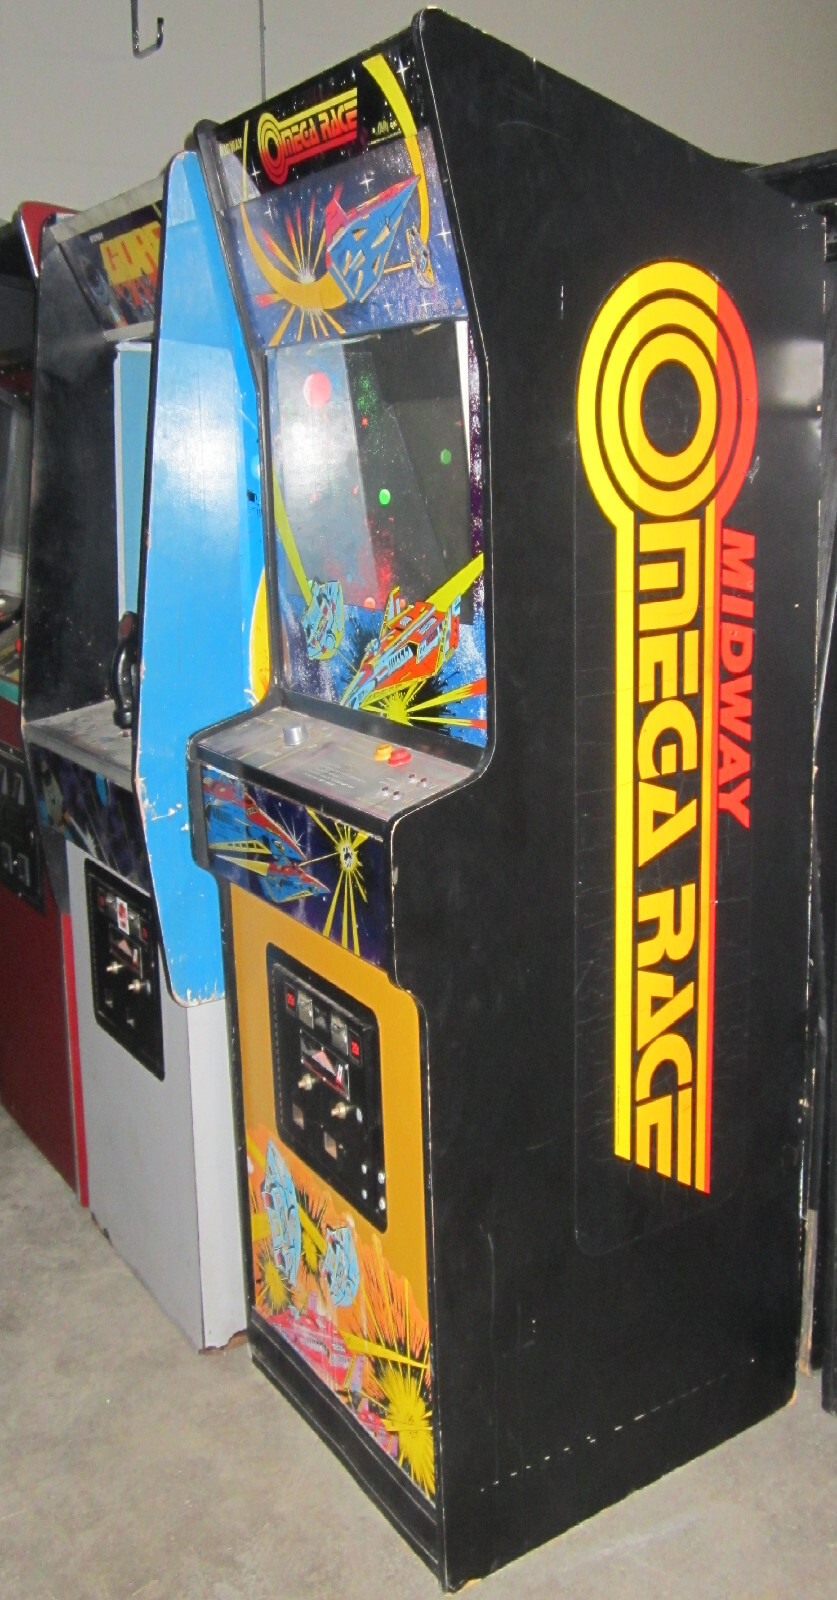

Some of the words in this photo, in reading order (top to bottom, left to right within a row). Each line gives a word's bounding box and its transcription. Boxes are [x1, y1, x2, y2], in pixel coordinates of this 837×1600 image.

[257, 112, 320, 185] OMEGA
[318, 96, 358, 140] RACE
[576, 261, 758, 868] OMEGA
[715, 527, 756, 829] MIDWAY
[636, 883, 697, 1186] RACE
